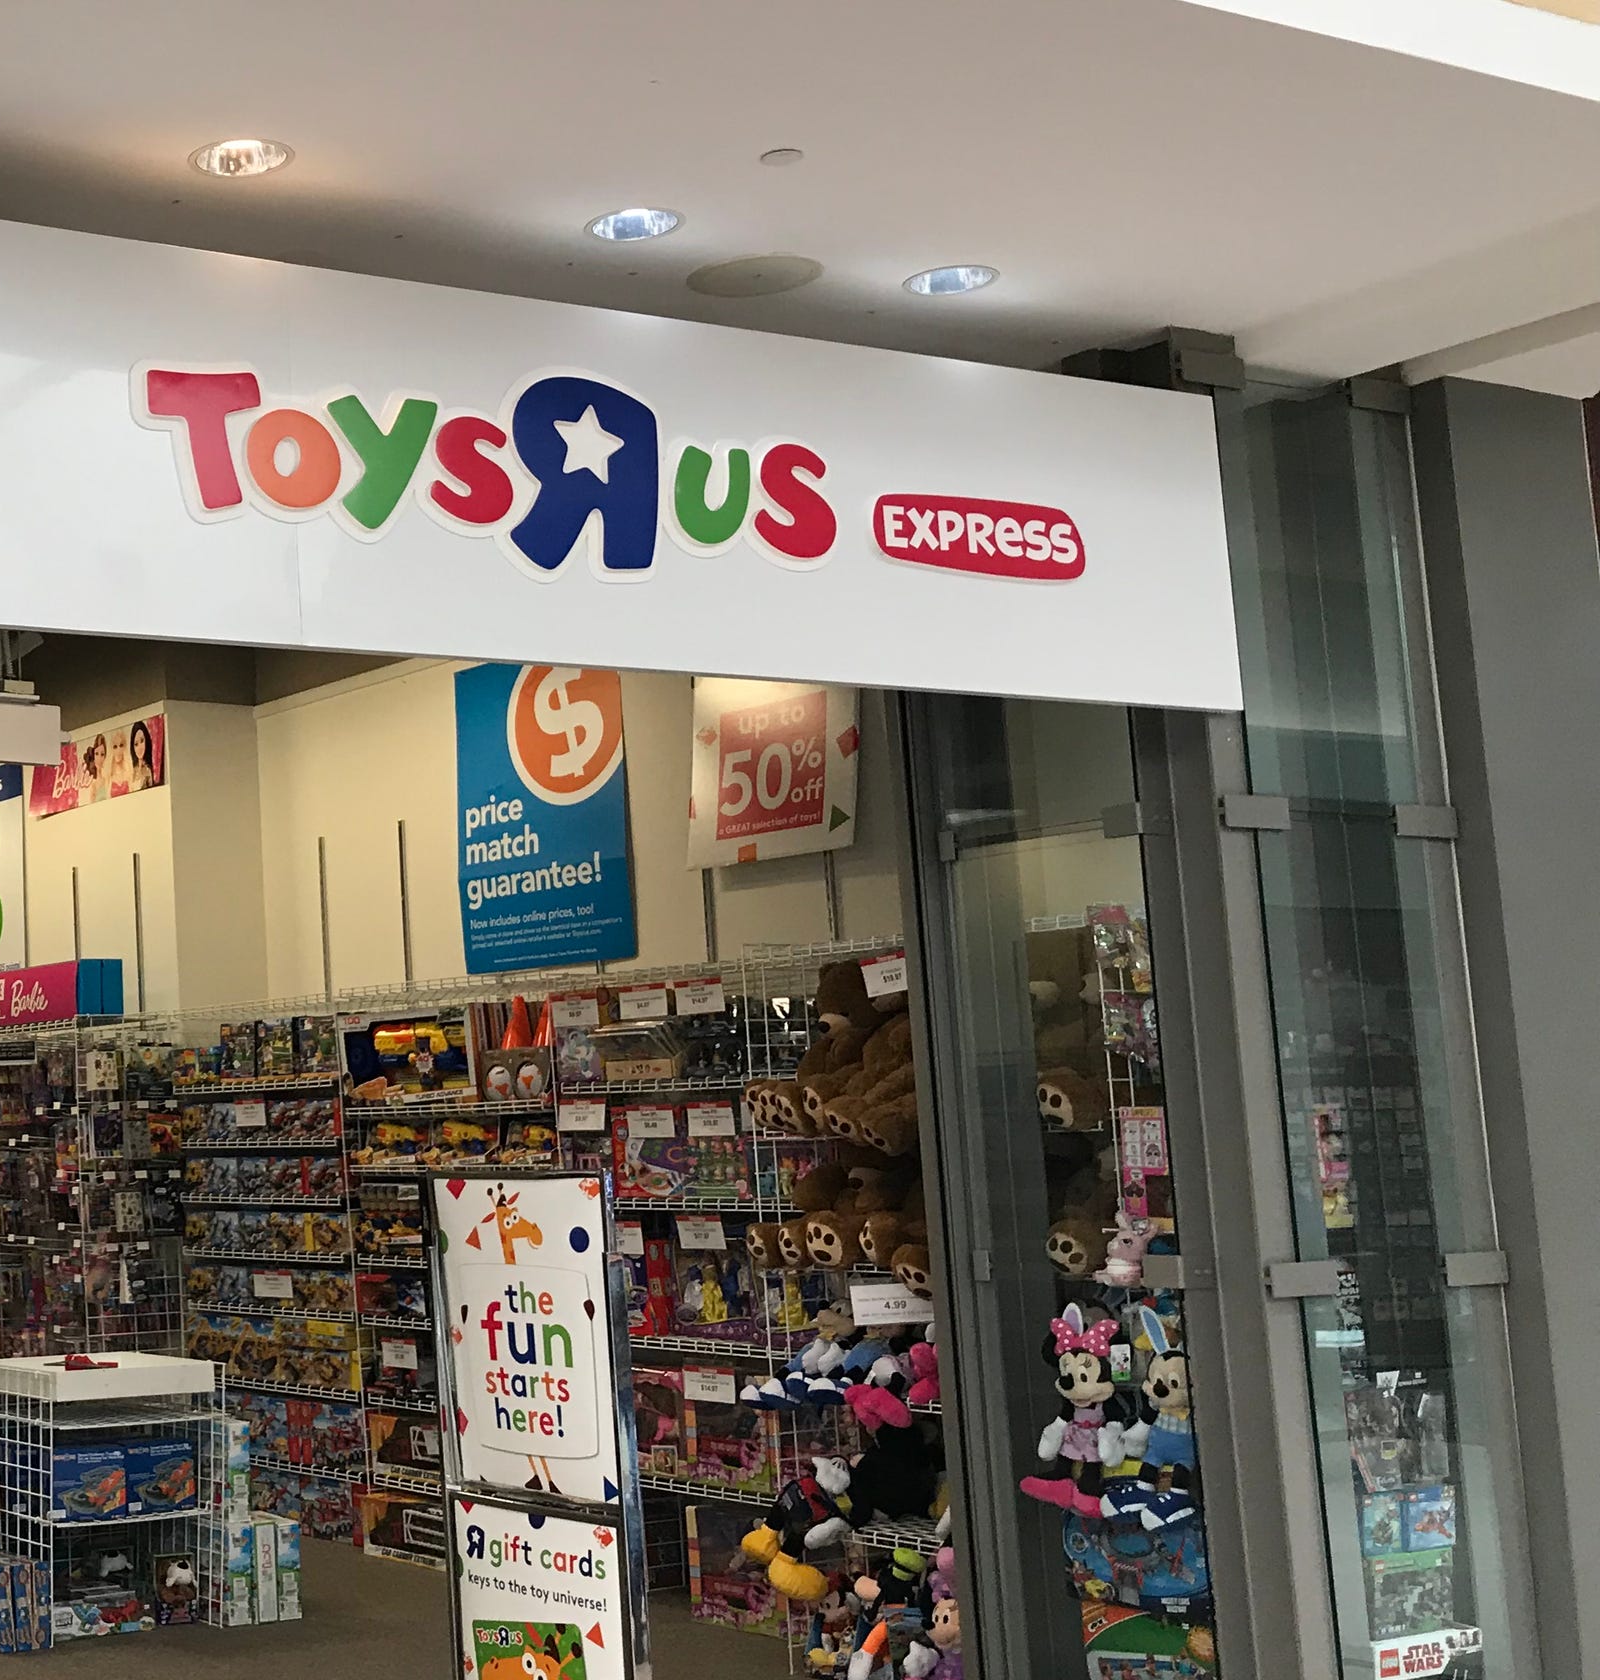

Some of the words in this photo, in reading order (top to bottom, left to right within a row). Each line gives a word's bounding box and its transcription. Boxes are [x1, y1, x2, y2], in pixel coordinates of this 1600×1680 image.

[738, 712, 770, 739] up
[780, 703, 805, 725] to
[719, 736, 822, 817] 50%
[791, 776, 823, 803] off
[465, 794, 523, 838] price
[725, 822, 751, 834] GREAT
[789, 813, 798, 823] of
[465, 825, 539, 866] match
[466, 851, 602, 910] guarantee!
[470, 918, 488, 930] Now
[489, 914, 521, 928] includes
[522, 910, 547, 923] online
[549, 907, 576, 923] prices,
[10, 979, 49, 1018] Barbie
[504, 1281, 554, 1315] the
[883, 1300, 907, 1310] 4.99
[480, 1301, 574, 1368] fun
[485, 1366, 570, 1402] starts
[494, 1396, 564, 1438] here!
[489, 1532, 532, 1568] gift
[539, 1549, 606, 1580] cards
[468, 1569, 490, 1589] keys
[494, 1577, 505, 1591] to
[508, 1580, 527, 1595] the
[530, 1584, 550, 1604] toy
[552, 1591, 607, 1612] universe!
[1403, 1642, 1444, 1660] STAR
[1403, 1655, 1444, 1674] WARS
